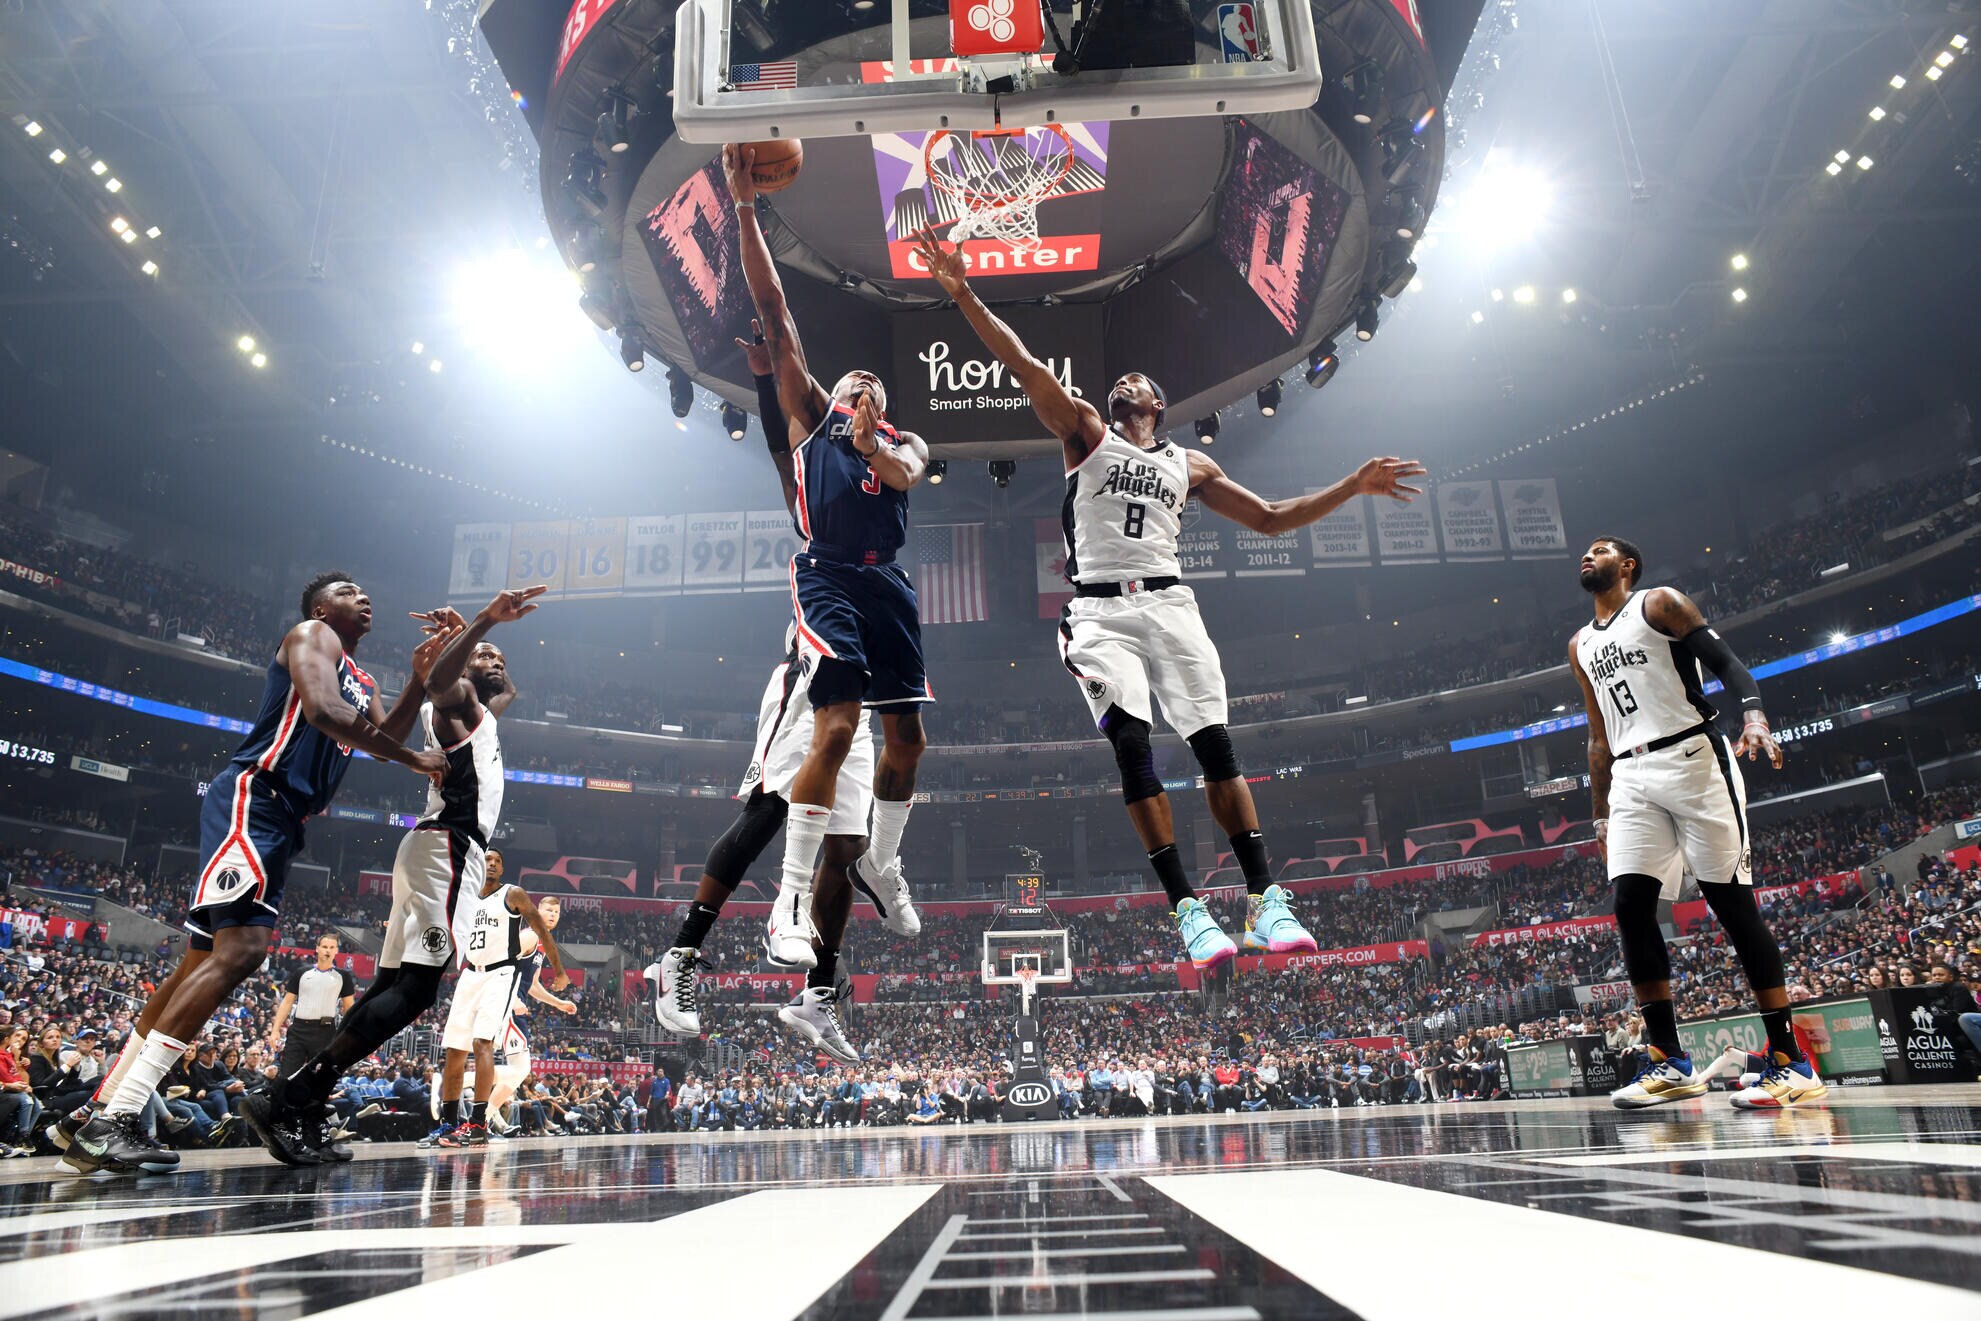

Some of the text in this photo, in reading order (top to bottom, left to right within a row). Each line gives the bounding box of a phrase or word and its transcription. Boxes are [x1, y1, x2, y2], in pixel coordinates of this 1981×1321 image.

[1228, 53, 1246, 63] NBA
[918, 341, 1083, 397] hony
[929, 397, 972, 411] Smart
[1120, 457, 1159, 481] Los
[1092, 464, 1177, 510] Angeles
[690, 521, 740, 532] GRETZKY
[1124, 502, 1146, 539] 8
[637, 524, 675, 535] TAYLOR
[1200, 531, 1218, 541] CUP
[751, 537, 796, 569] 20
[1237, 539, 1298, 551] CHAMPIONS
[578, 545, 612, 578] 16
[636, 544, 671, 575] 18
[692, 539, 736, 572] 99
[1248, 553, 1291, 566] 2011-12
[514, 550, 558, 581] 30
[1593, 640, 1617, 665] Los
[1589, 646, 1648, 692] Angeles
[1608, 679, 1639, 717] 13
[1402, 744, 1444, 760] Spectrum
[81, 759, 98, 770] UCLA
[590, 780, 610, 788] WELLS
[611, 782, 631, 790] FARGO
[1170, 781, 1187, 789] LIGHT
[1531, 780, 1576, 796] STAPLES
[338, 809, 376, 821] BUD LIGHT
[1017, 877, 1039, 888] 4:39
[1021, 889, 1036, 906] 12
[470, 930, 486, 951] 23
[1287, 949, 1377, 967] CLIPPERS.COM
[1832, 1015, 1873, 1033] SUBWAY
[1879, 1036, 1897, 1047] AGUA
[1907, 1035, 1953, 1050] AGUA
[1908, 1051, 1956, 1061] CALIENTE
[1586, 1066, 1616, 1076] AGUA
[1914, 1061, 1954, 1069] CASINOS
[1587, 1074, 1617, 1083] CALIENTE
[1015, 1087, 1044, 1103] KIA
